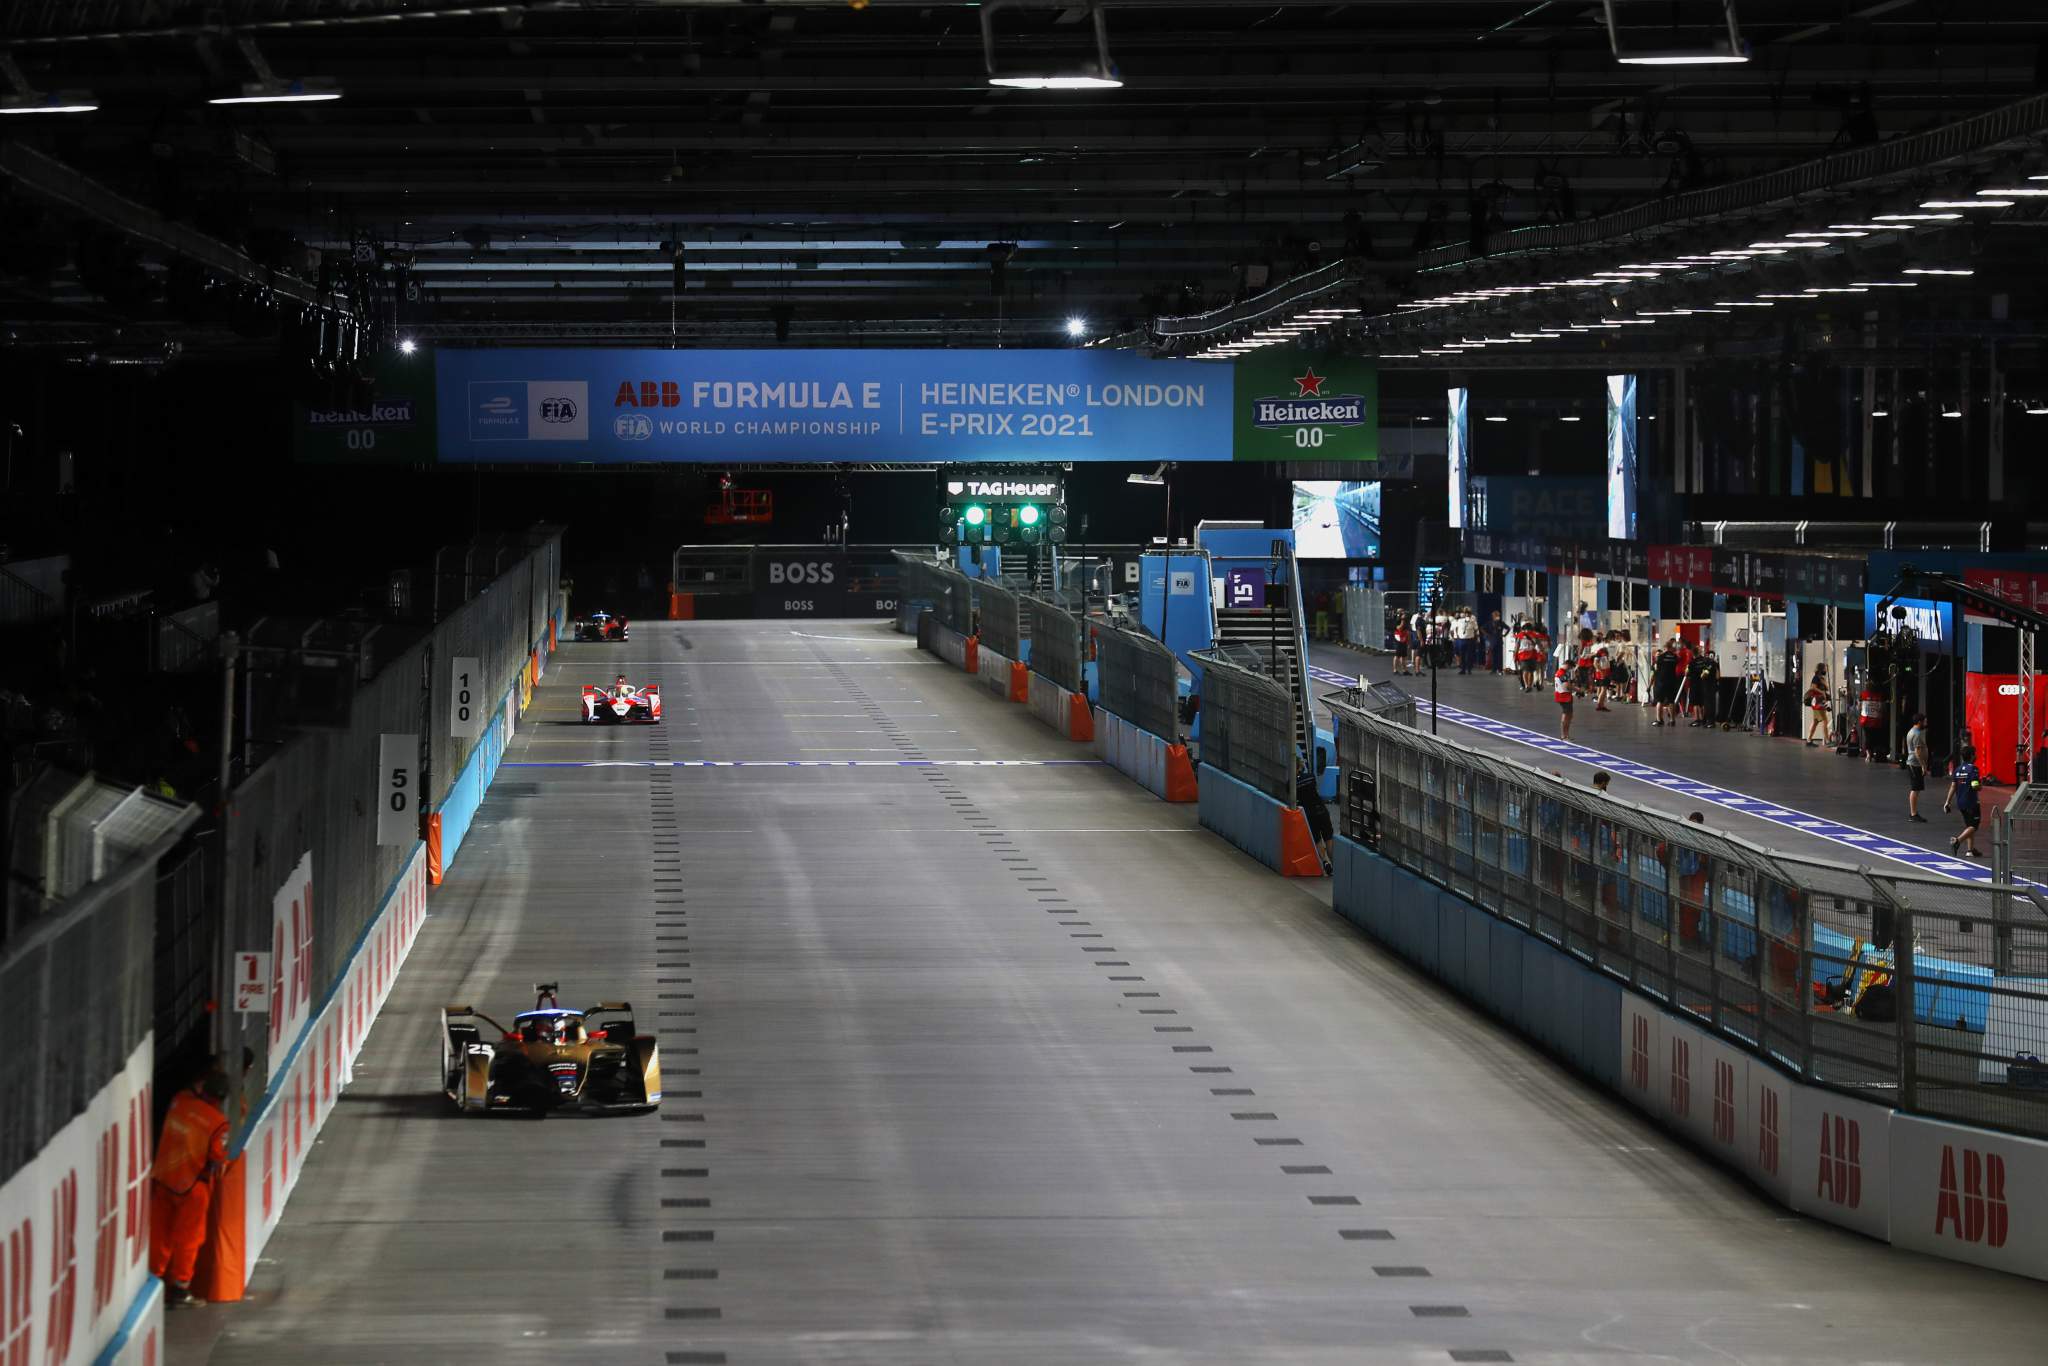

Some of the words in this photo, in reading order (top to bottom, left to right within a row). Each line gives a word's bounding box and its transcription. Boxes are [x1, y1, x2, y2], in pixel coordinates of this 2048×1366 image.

[614, 381, 680, 408] ABB
[693, 381, 854, 409] FORMULA
[862, 382, 881, 409] E
[1086, 384, 1205, 407] LONDON
[1259, 402, 1360, 422] Heineken
[660, 421, 727, 435] WORLD
[734, 421, 881, 435] CHAMPIONSHIP
[920, 413, 1015, 435] E-PRIX
[1020, 414, 1094, 437] 2021
[1295, 427, 1323, 448] 0.0
[769, 562, 835, 584] BOSS
[784, 600, 814, 611] BOSS
[1670, 1035, 1690, 1119] ABB
[1712, 1057, 1735, 1145] ABB
[1758, 1084, 1780, 1178] ABB
[1817, 1111, 1862, 1211] ABB
[1934, 1144, 2009, 1249] ABB
